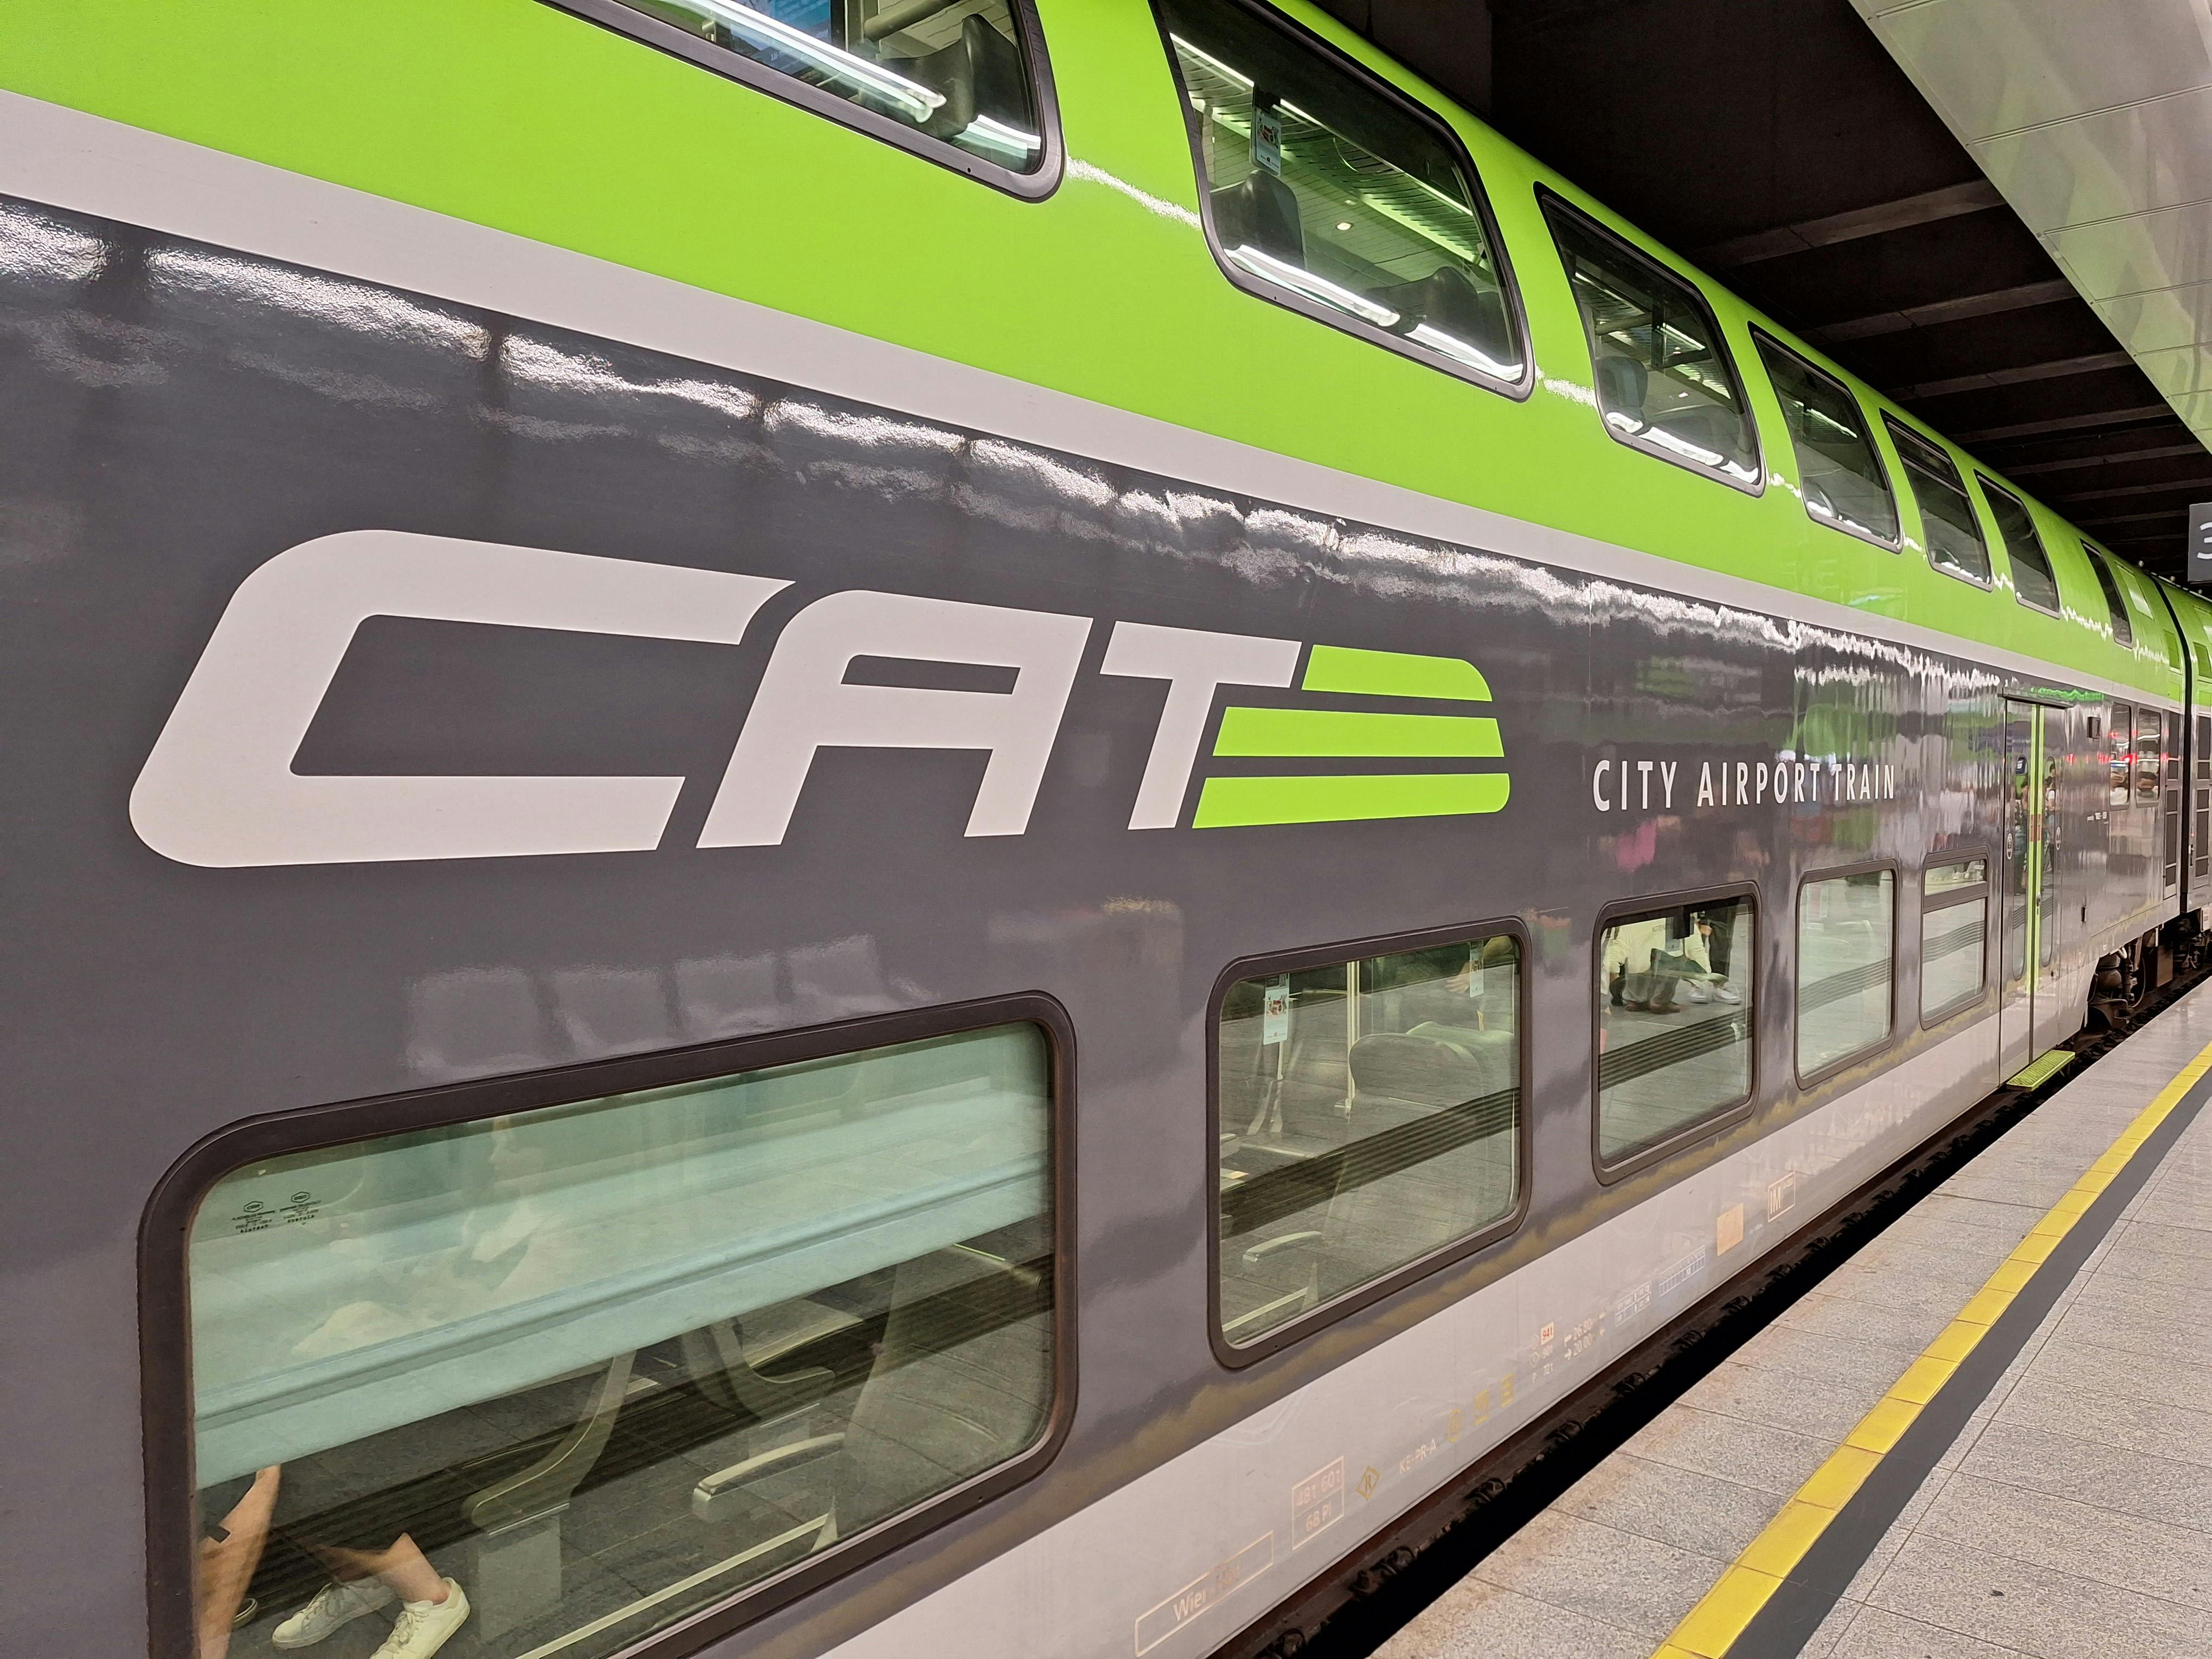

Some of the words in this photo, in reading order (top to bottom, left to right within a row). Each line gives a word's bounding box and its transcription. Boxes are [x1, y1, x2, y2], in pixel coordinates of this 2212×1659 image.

[129, 530, 1302, 867] CAT
[1593, 760, 1677, 812] CITY
[1697, 762, 1820, 807] AIRPORT
[1833, 763, 1894, 801] TRAIN
[1399, 1438, 1436, 1475] KE-PR-A
